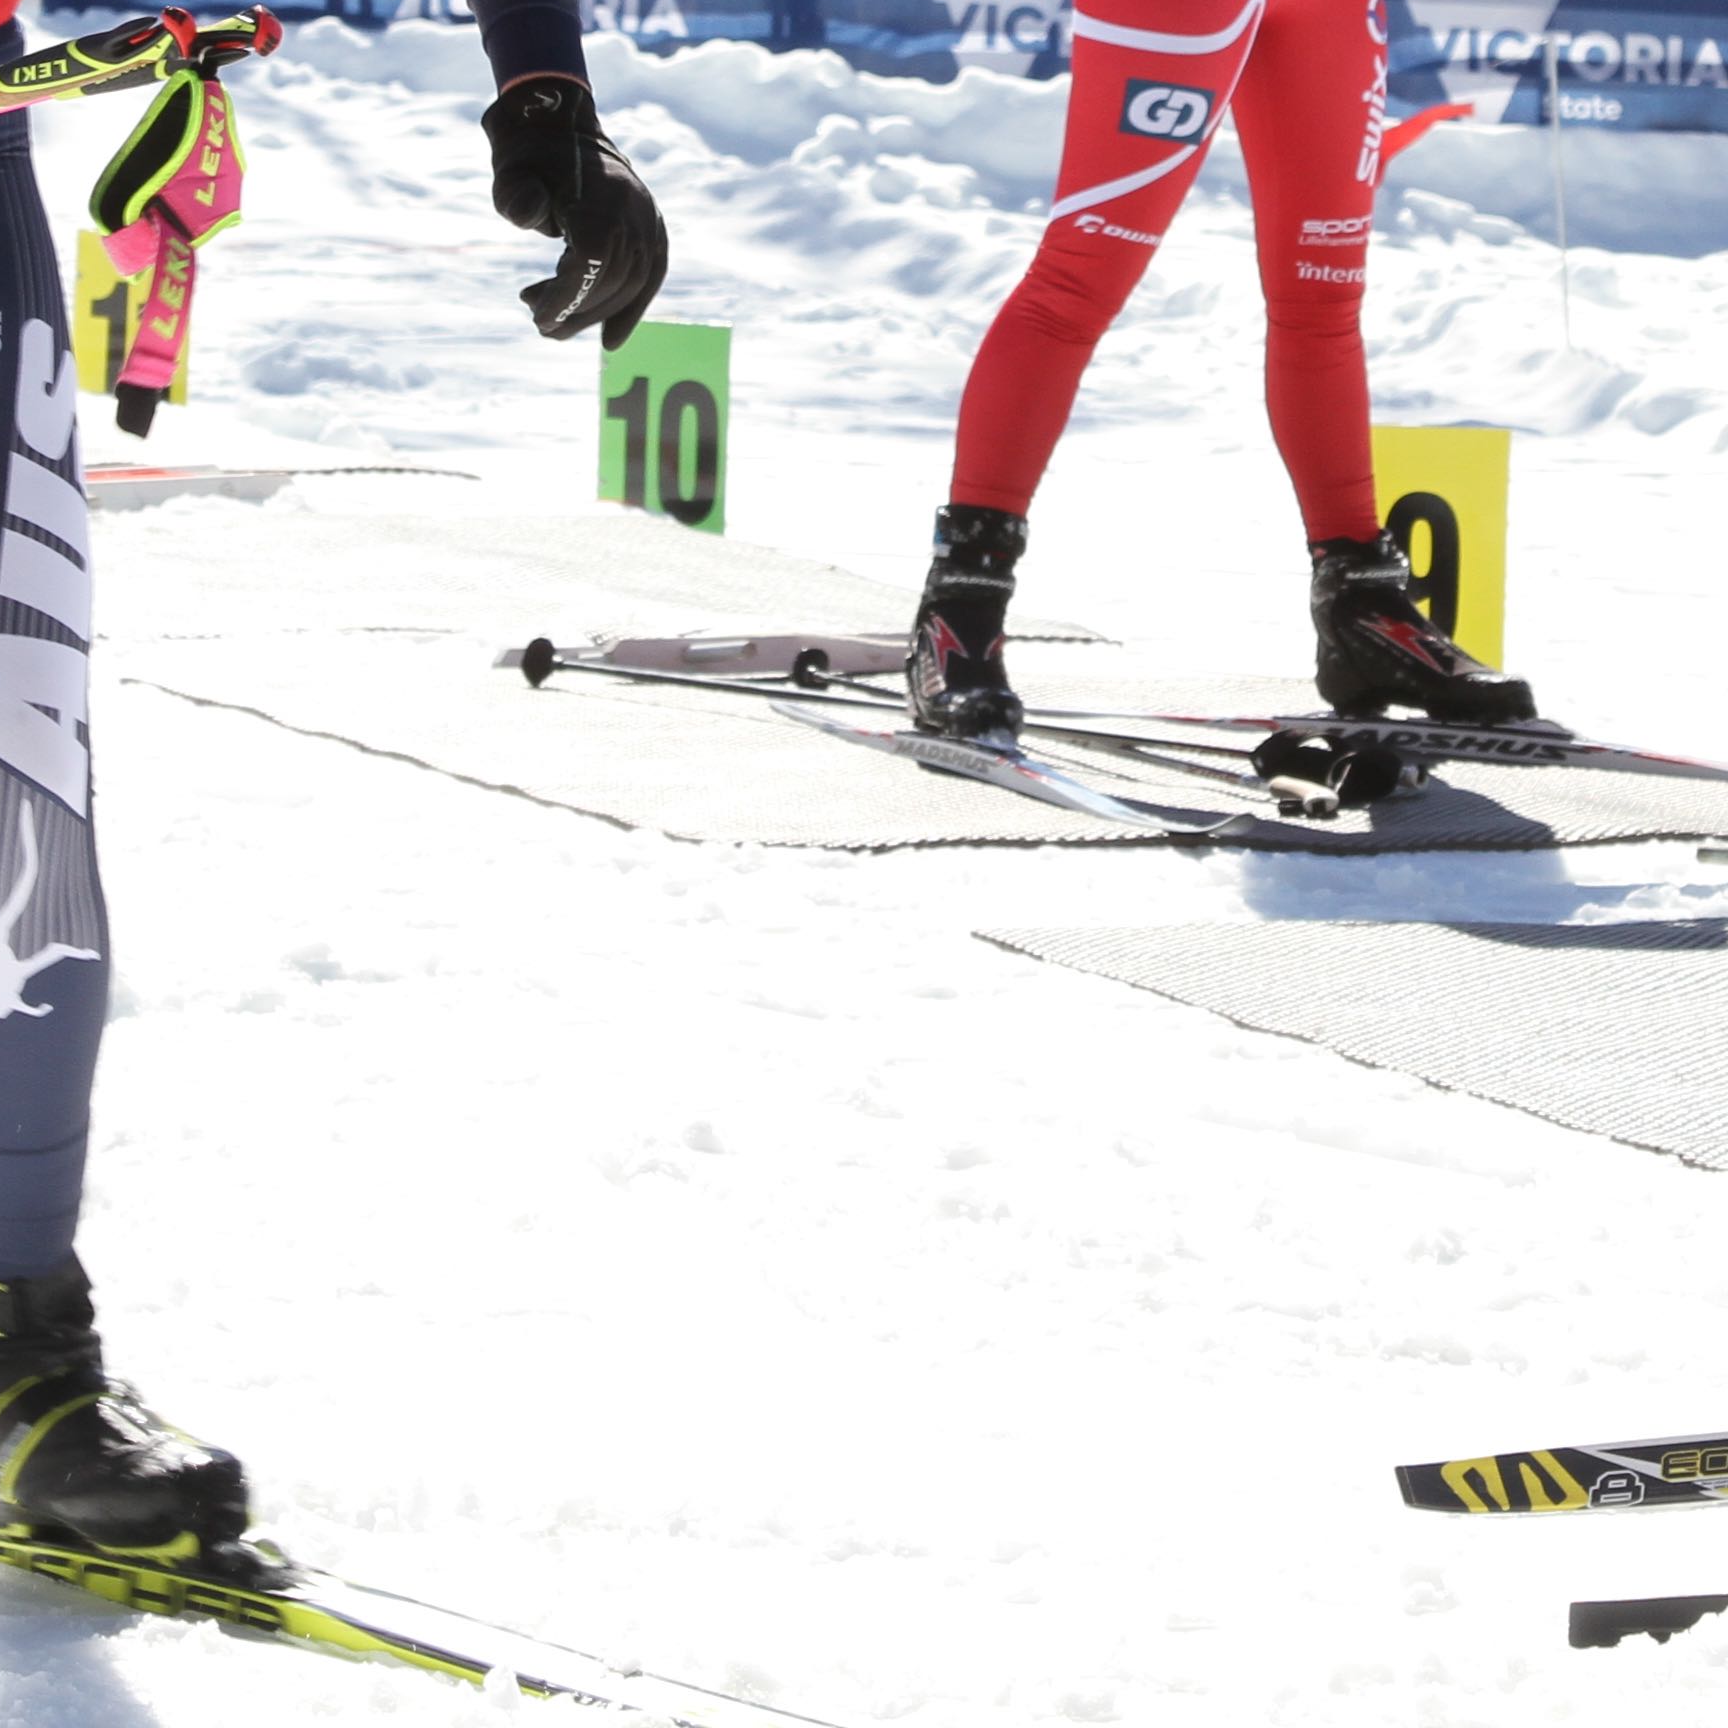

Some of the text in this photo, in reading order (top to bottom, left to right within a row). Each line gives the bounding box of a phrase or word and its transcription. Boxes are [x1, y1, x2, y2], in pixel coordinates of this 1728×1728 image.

[13, 58, 69, 85] LEKI
[193, 93, 226, 208] LEKI
[151, 236, 194, 342] LEKI
[555, 258, 603, 323] Roeckl
[606, 375, 720, 527] 10
[1385, 490, 1461, 642] 9
